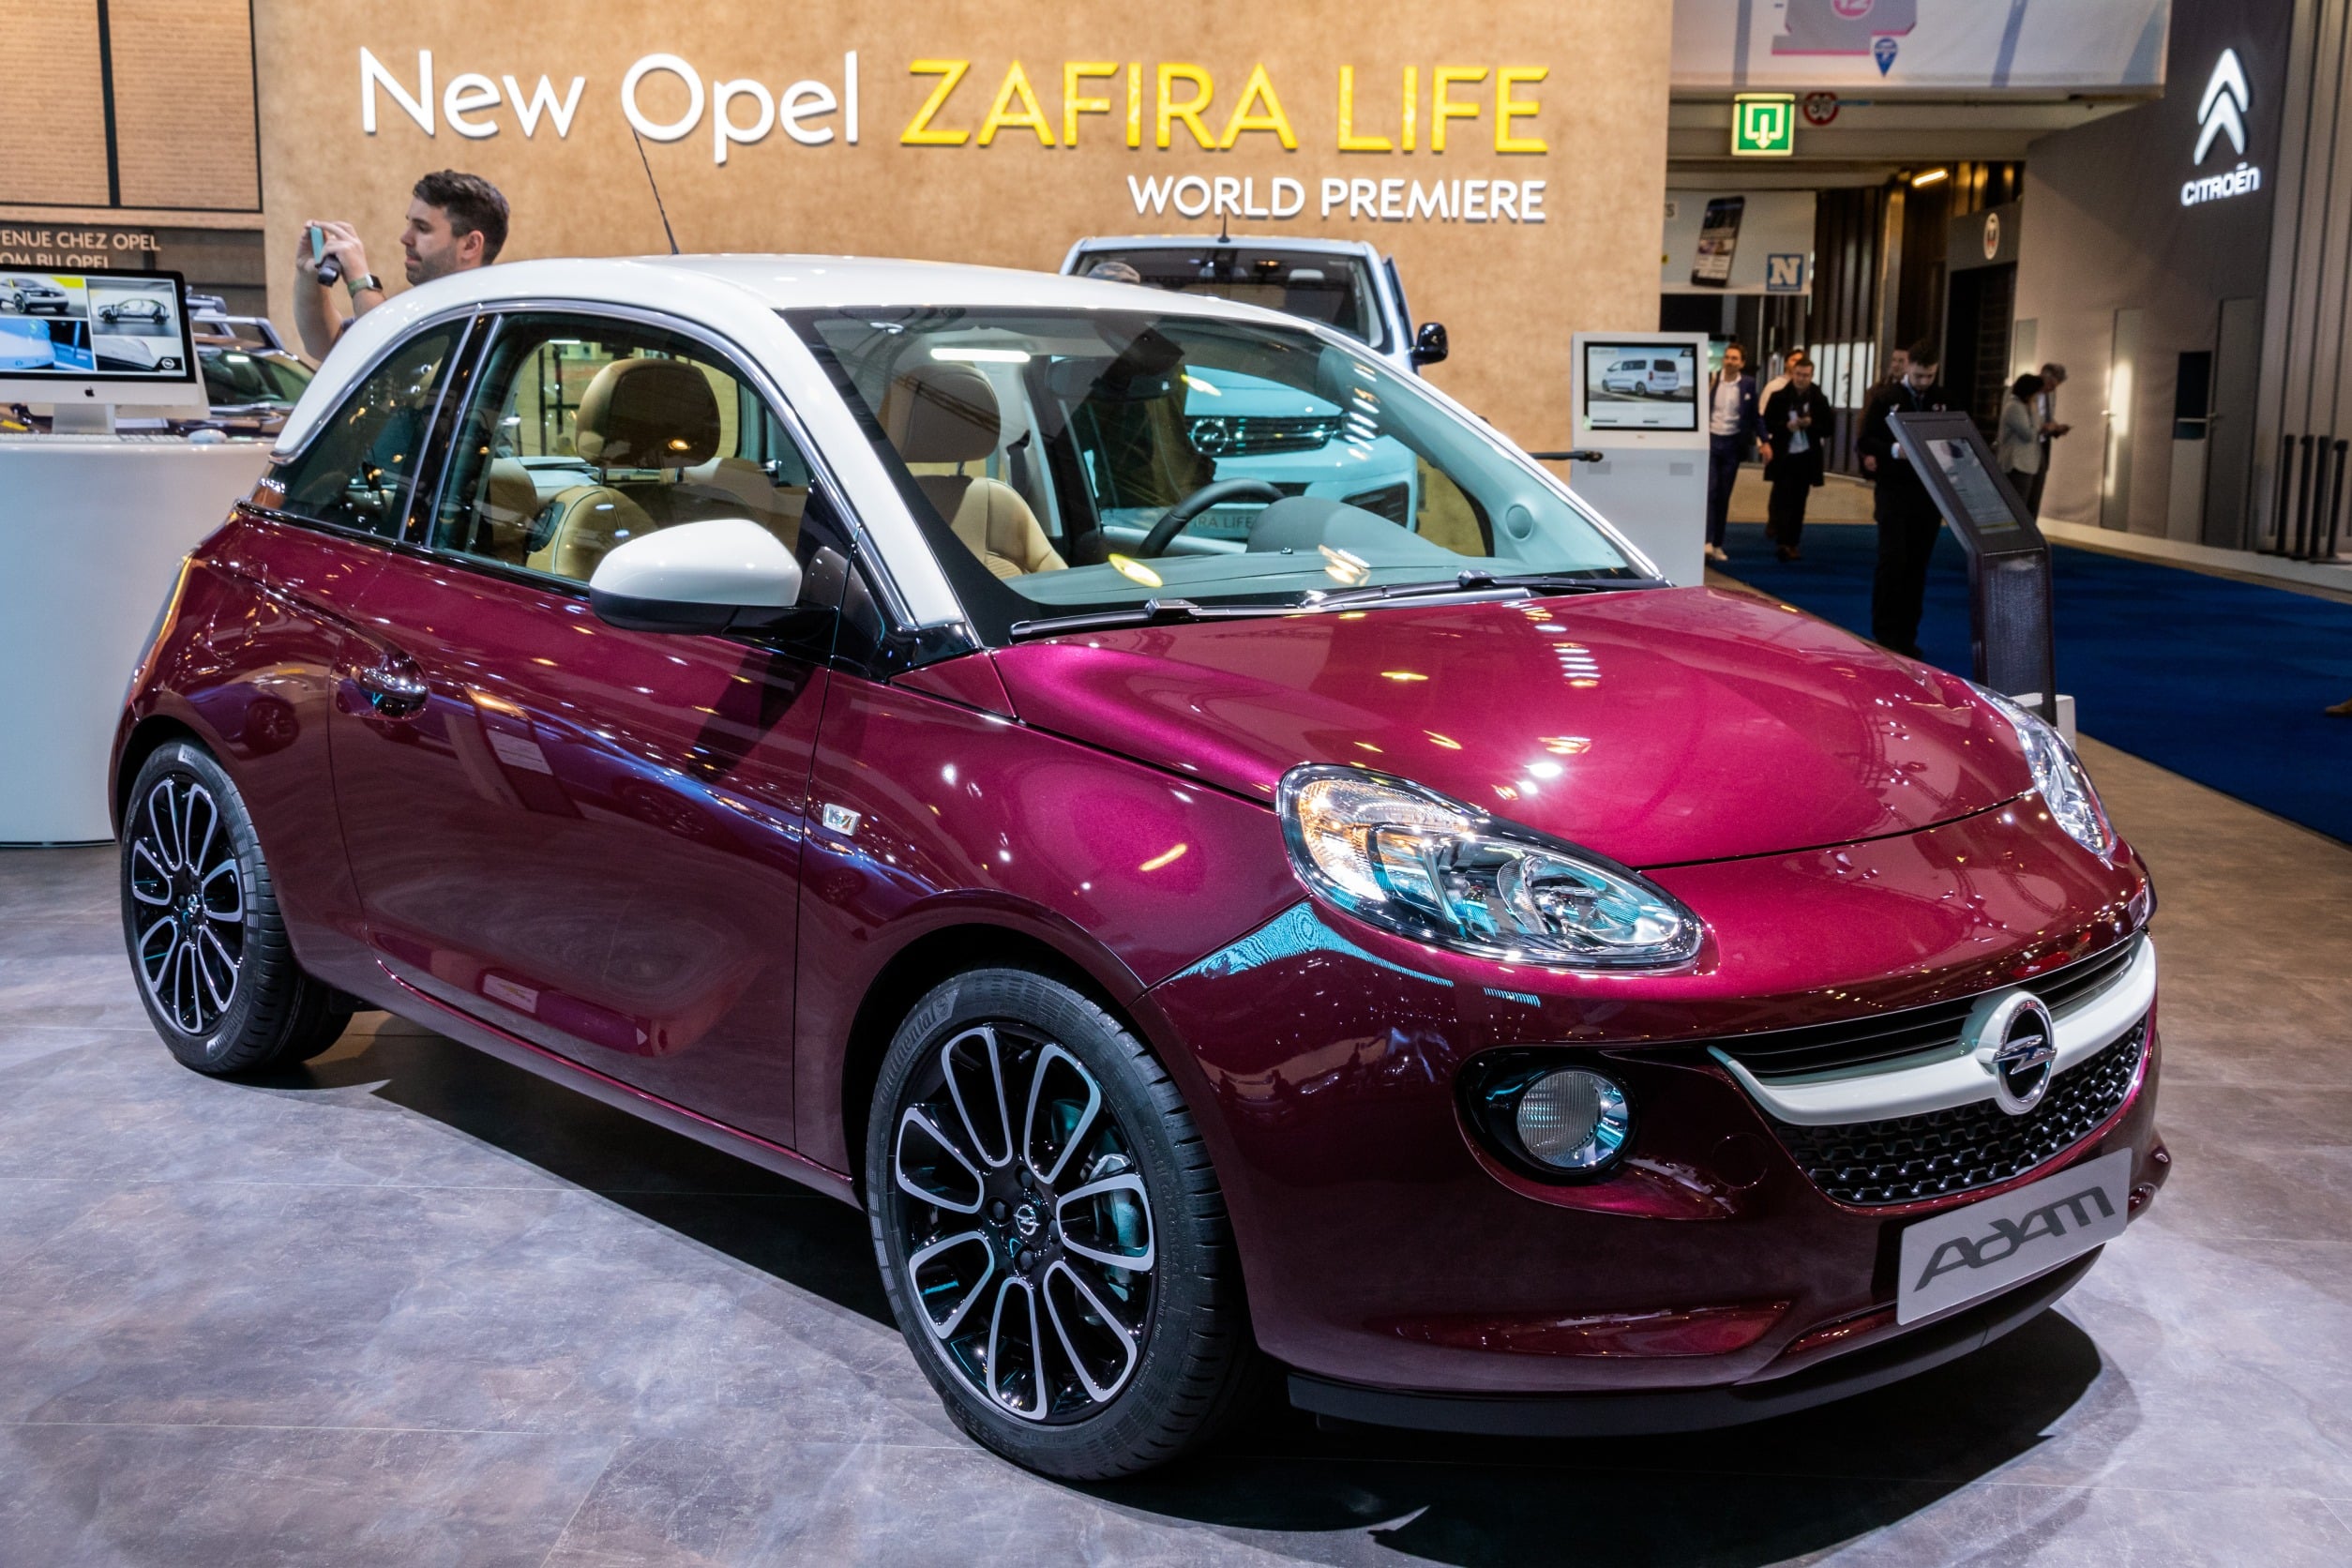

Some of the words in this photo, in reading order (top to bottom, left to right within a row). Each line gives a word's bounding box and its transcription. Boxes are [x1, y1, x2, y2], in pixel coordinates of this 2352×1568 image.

[359, 45, 586, 140] New
[621, 50, 859, 166] Opel
[900, 59, 1299, 150] ZAFIRA
[1338, 65, 1548, 153] LIFE
[1127, 174, 1305, 218] WORLD
[1321, 177, 1546, 222] PREMIERE
[0, 230, 53, 248] ENUE
[56, 232, 108, 249] CHEZ
[113, 234, 161, 251] OPEL
